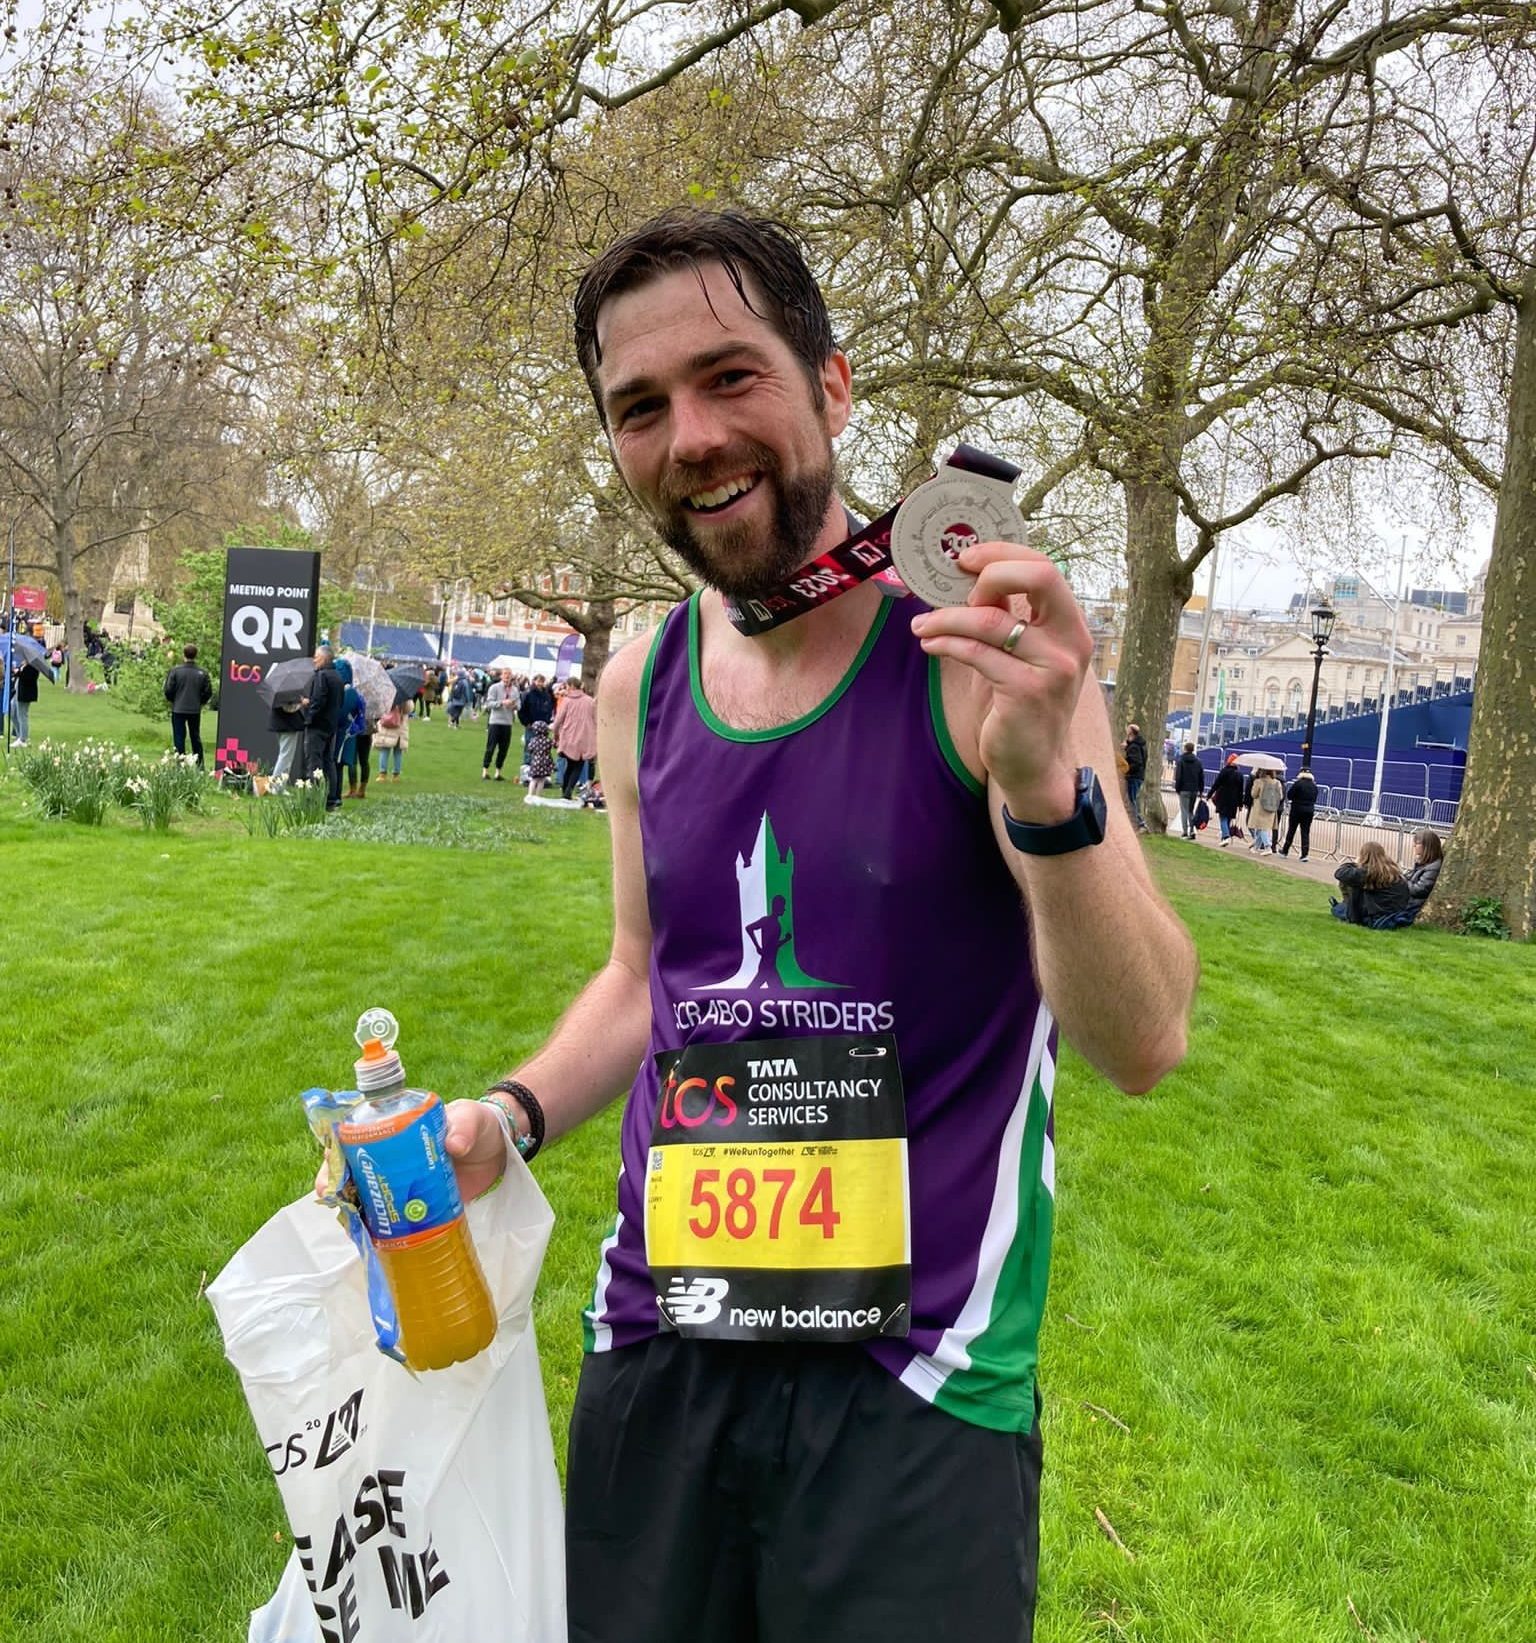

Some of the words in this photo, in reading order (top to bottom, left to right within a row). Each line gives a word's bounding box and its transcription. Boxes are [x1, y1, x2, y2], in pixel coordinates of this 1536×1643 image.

[229, 584, 275, 597] MEETING
[277, 587, 310, 598] POINT
[231, 605, 304, 654] QR
[230, 659, 262, 683] tcs
[760, 1000, 895, 1032] STRIDERS
[747, 1058, 798, 1078] TATA
[748, 1079, 882, 1102] CONSULTANCY
[748, 1105, 829, 1126] SERVICES
[723, 1147, 795, 1157] #WeRunTogether
[688, 1166, 841, 1240] 5874
[729, 1306, 777, 1328] new
[782, 1302, 881, 1329] balance
[305, 1418, 321, 1432] 20
[378, 1544, 450, 1620] ME
